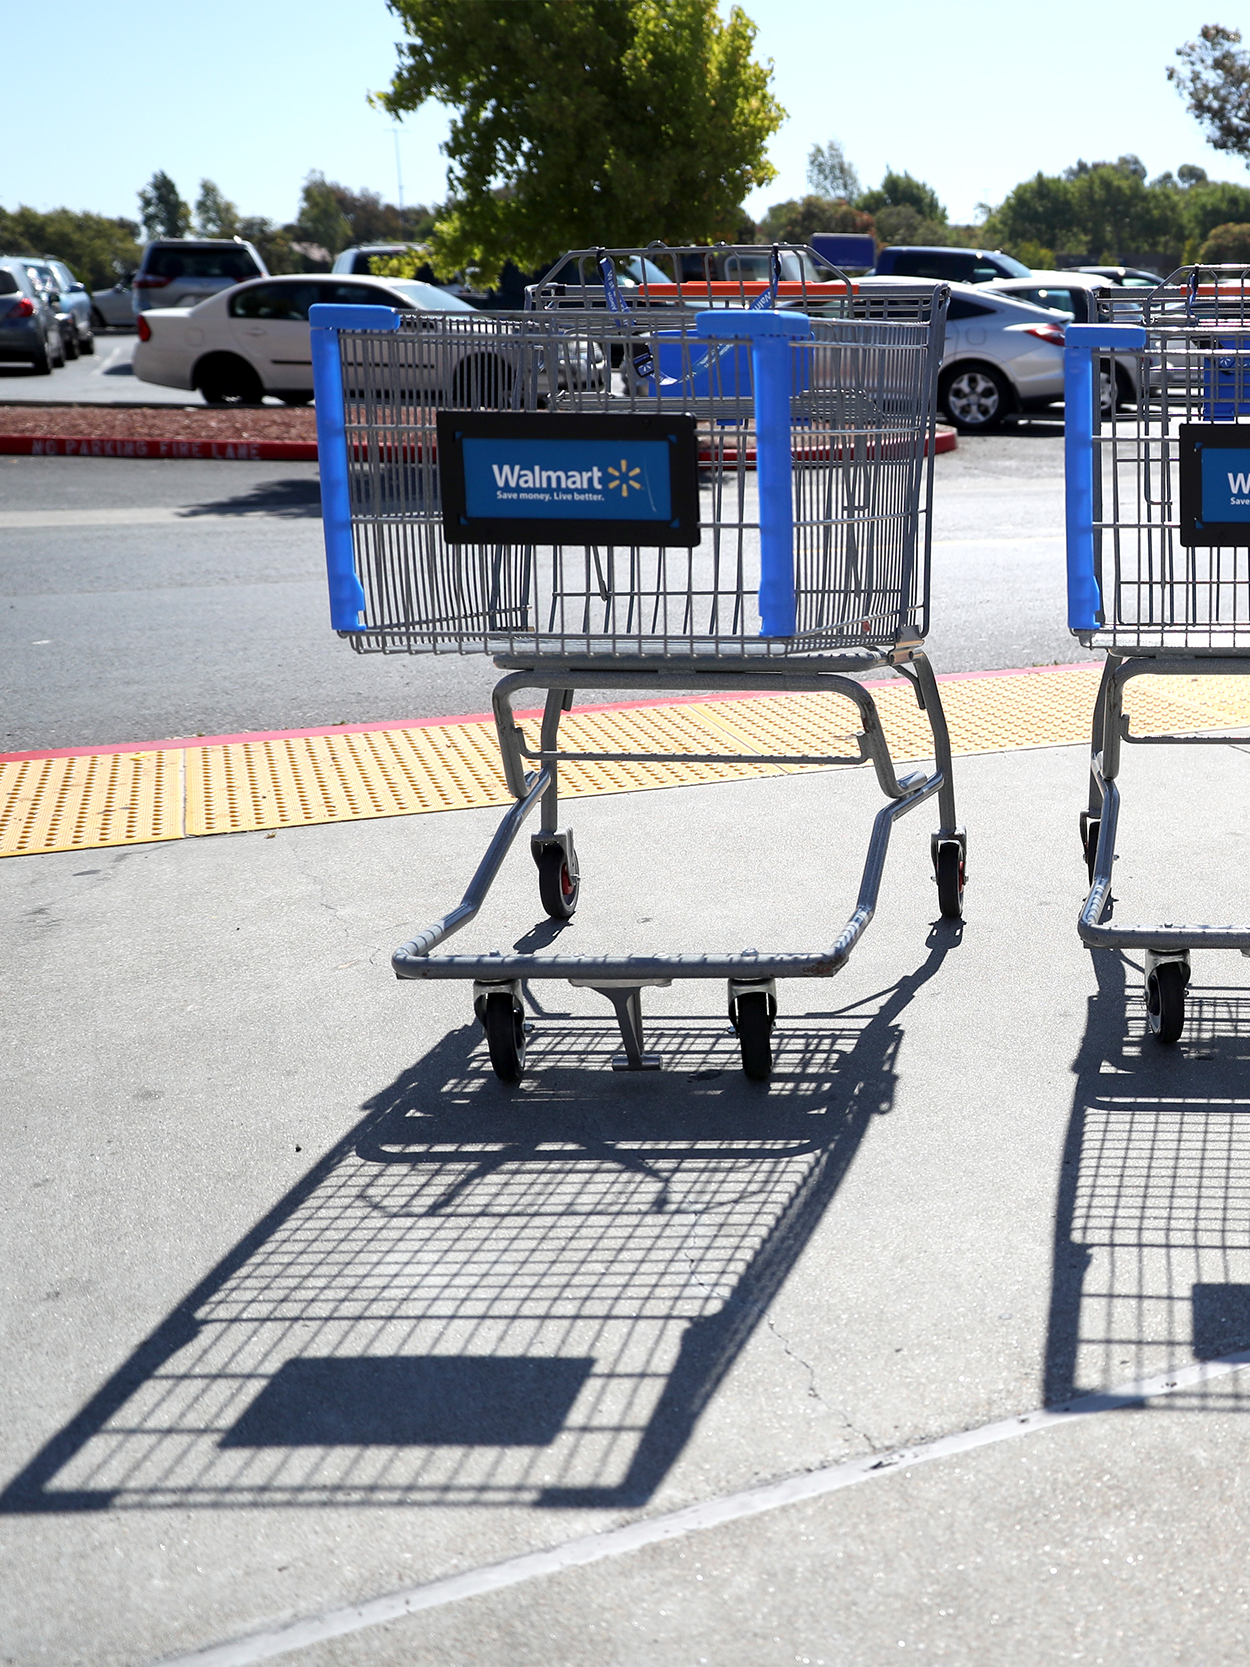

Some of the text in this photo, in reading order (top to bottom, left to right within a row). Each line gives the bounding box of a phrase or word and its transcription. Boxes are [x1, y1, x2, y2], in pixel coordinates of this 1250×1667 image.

[32, 439, 262, 461] NO PARKING FIRE LANE
[491, 464, 603, 490] Walmart
[496, 490, 605, 502] Save money. Live better.
[1230, 496, 1250, 506] Save
